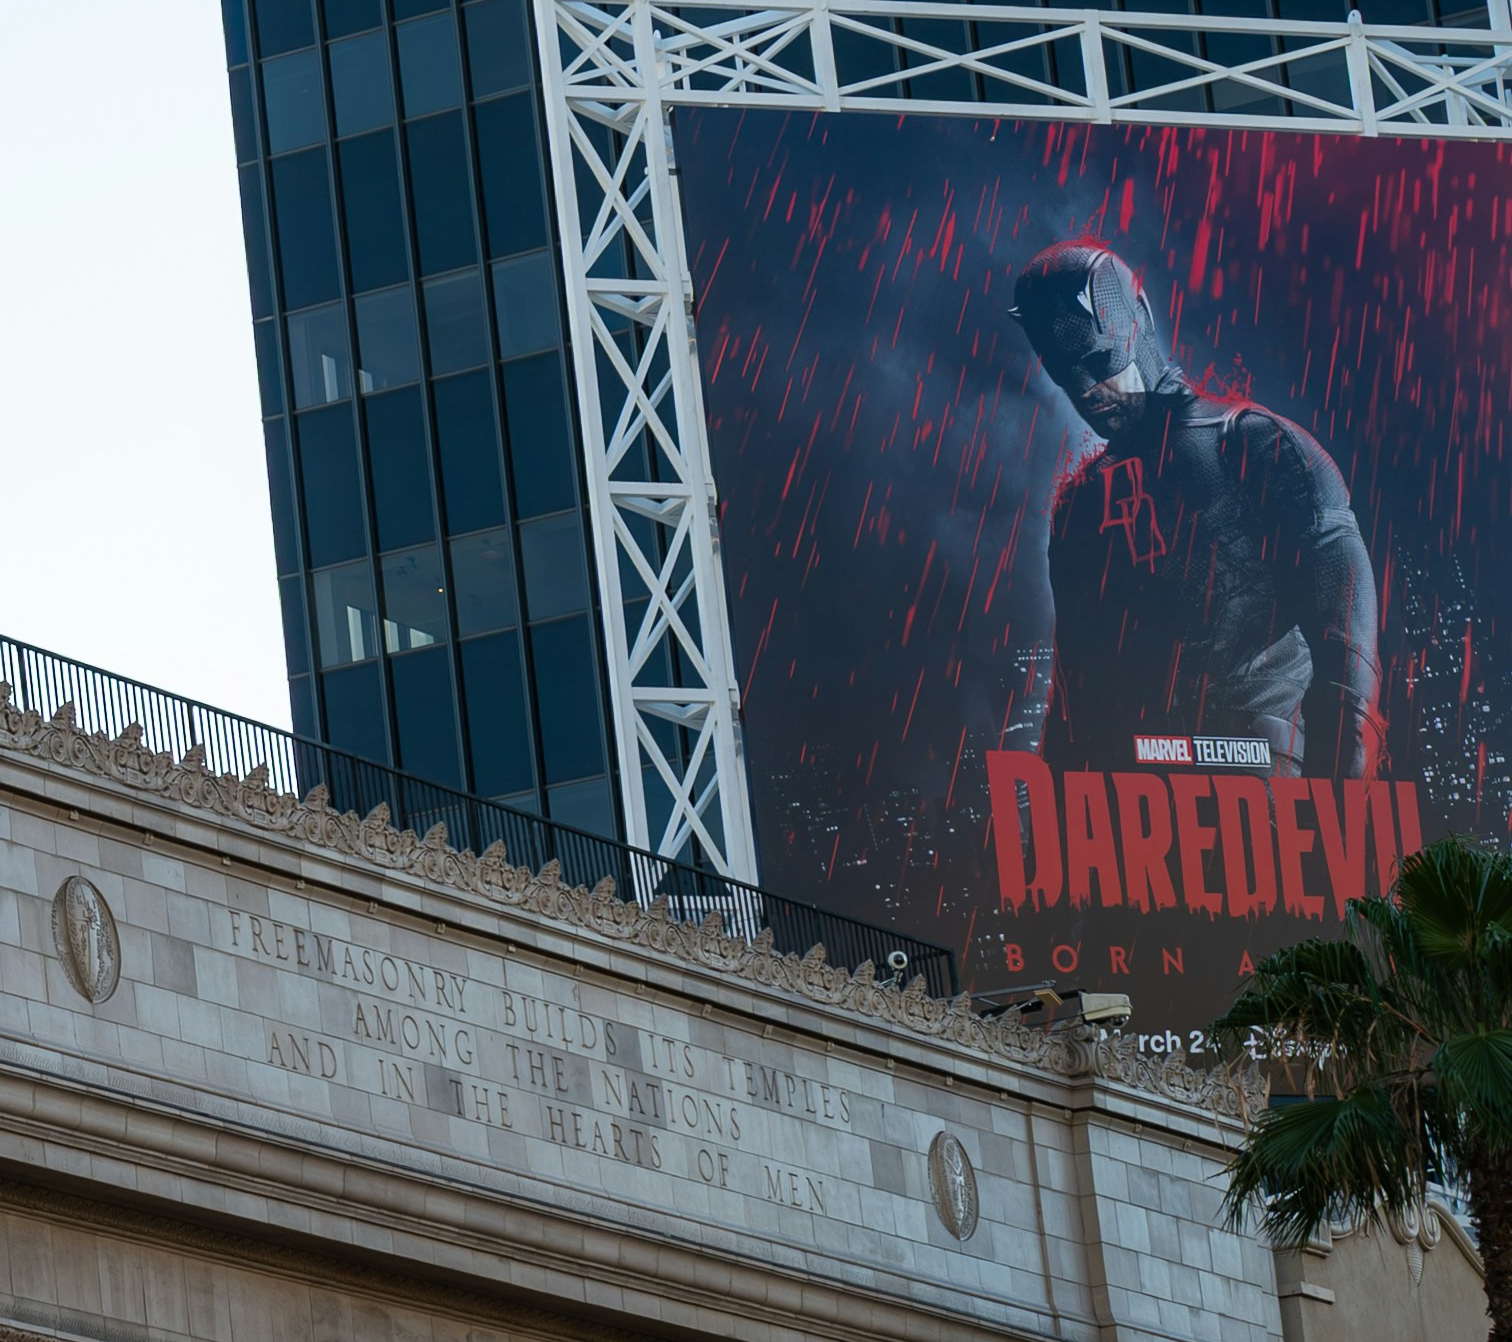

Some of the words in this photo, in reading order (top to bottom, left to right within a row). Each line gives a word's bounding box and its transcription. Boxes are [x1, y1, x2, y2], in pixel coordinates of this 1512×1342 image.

[1135, 737, 1192, 763] MARVEL
[1193, 738, 1271, 765] TELEVISION
[1005, 943, 1186, 976] BORN
[227, 909, 469, 1014] FREEMASONRY
[501, 989, 617, 1057] BUILDS
[648, 1033, 695, 1079] ITS
[721, 1055, 851, 1125] TEMPLES
[1099, 1028, 1182, 1053] rch
[353, 1002, 474, 1066] AMONG
[505, 1043, 569, 1094] THE
[600, 1069, 742, 1141] NATIONS
[267, 1030, 338, 1079] AND
[377, 1058, 415, 1102] IN
[449, 1079, 514, 1129] THE
[546, 1105, 663, 1170] HEARTS
[696, 1148, 729, 1188] OF
[763, 1165, 827, 1216] MEN
